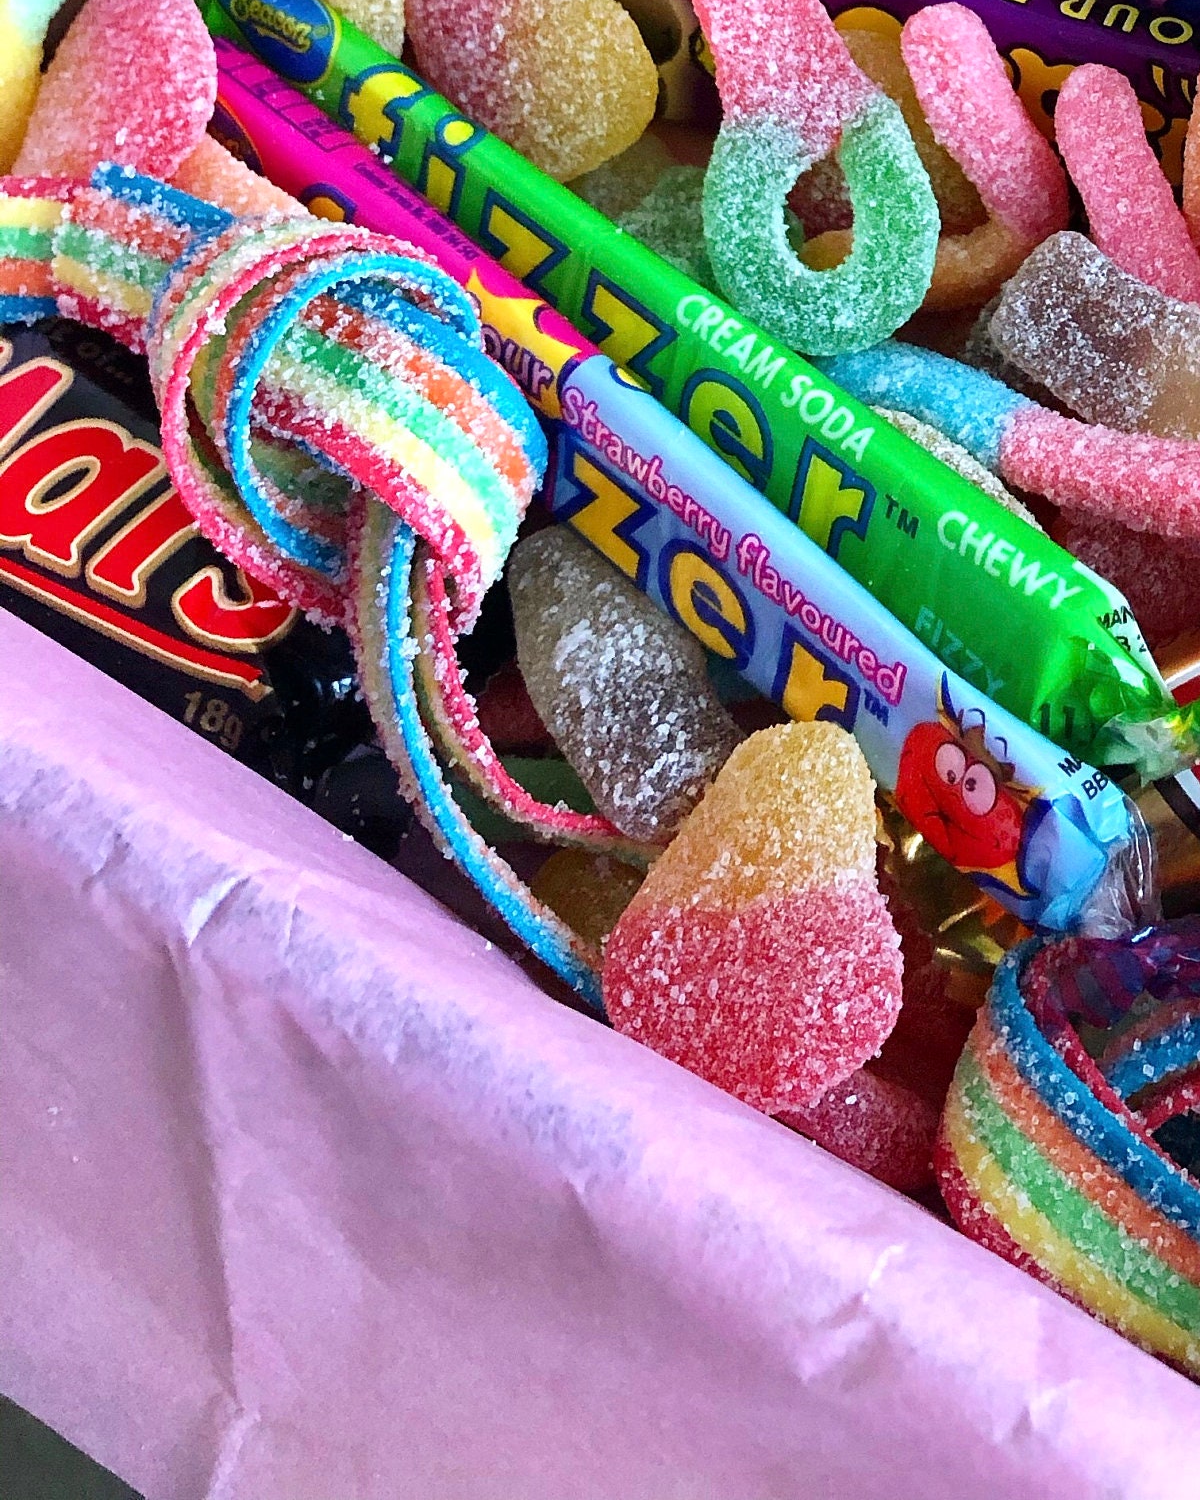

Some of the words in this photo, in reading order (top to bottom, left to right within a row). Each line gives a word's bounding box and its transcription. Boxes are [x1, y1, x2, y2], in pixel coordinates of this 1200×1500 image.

[338, 64, 878, 558] fizzer
[481, 324, 555, 401] our
[675, 294, 789, 389] CREAM
[779, 375, 878, 463] SODA
[561, 385, 732, 562] Strawberry
[736, 532, 908, 706] flavoured
[936, 510, 1084, 611] CHEWY
[912, 604, 1008, 693] FIZZY
[185, 691, 246, 749] 18g
